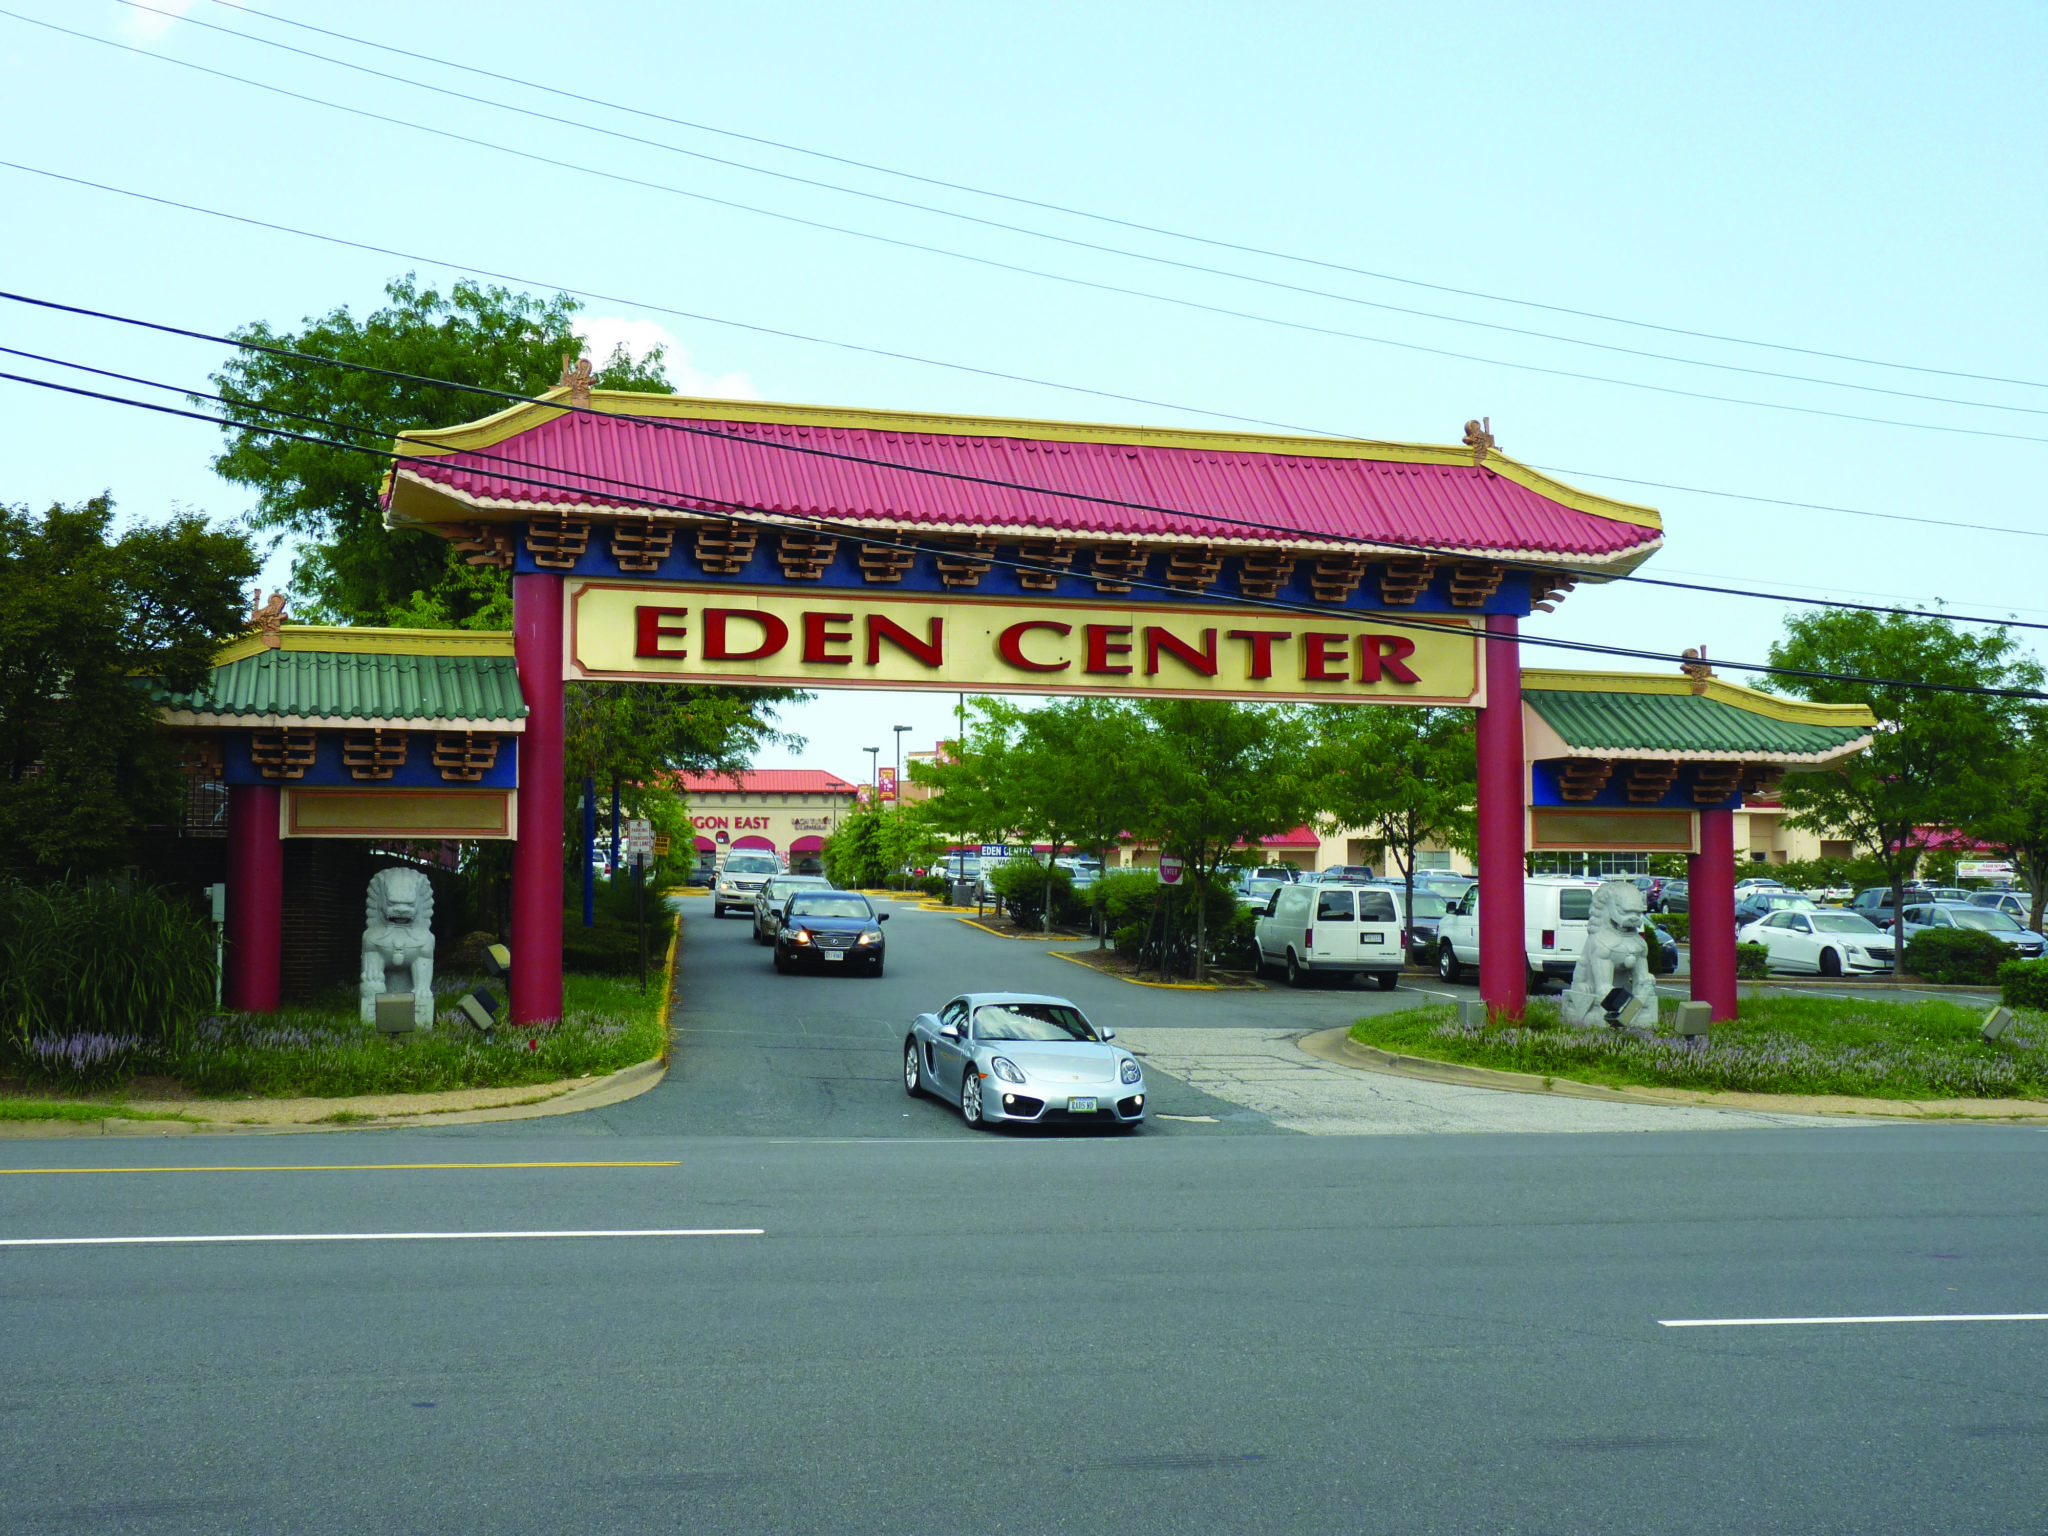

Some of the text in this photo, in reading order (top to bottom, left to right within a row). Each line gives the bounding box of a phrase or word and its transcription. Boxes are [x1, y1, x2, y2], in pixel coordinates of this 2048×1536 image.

[634, 605, 1422, 683] EDEN CENTER
[734, 816, 771, 830] EAST
[981, 846, 1034, 857] EDEN CENTER
[1164, 867, 1178, 876] ENTER
